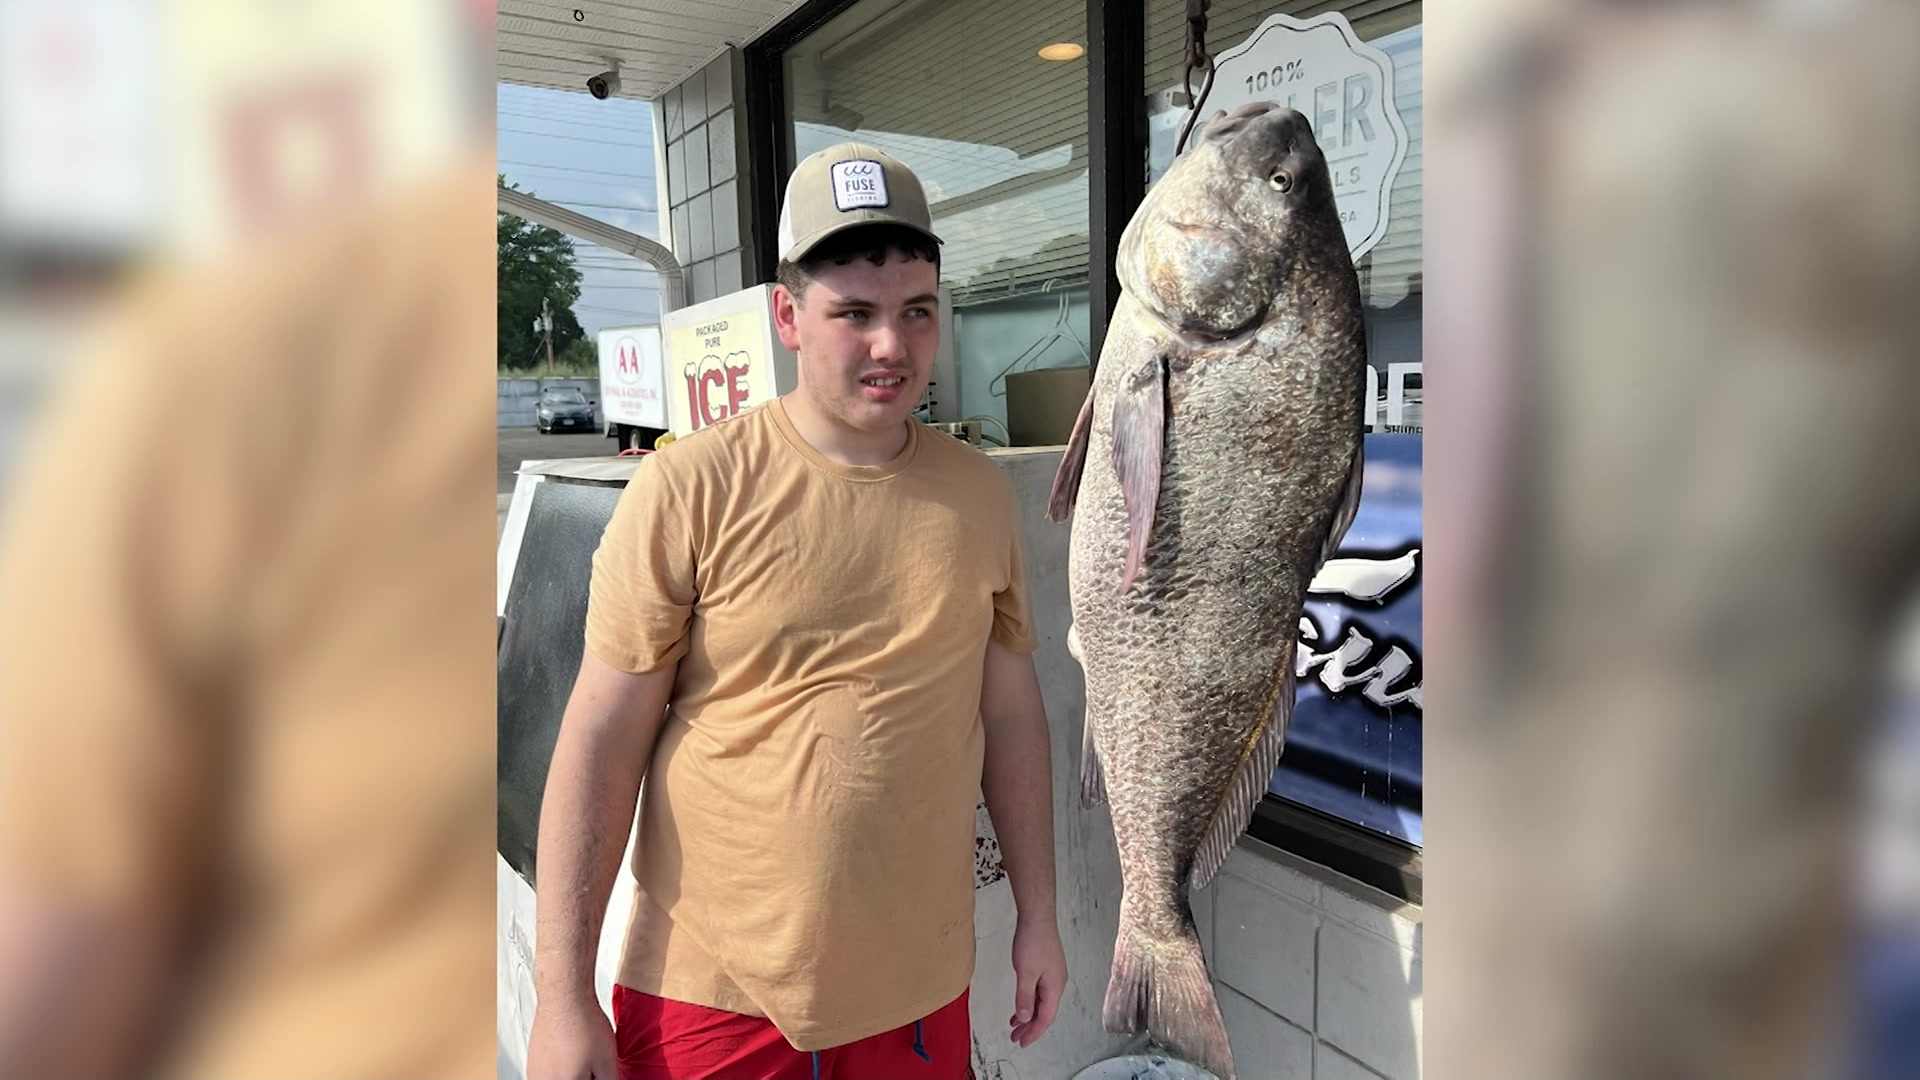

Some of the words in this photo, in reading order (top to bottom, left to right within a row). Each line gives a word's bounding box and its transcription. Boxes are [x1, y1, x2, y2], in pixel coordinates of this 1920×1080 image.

[1246, 59, 1304, 95] 100%
[845, 178, 876, 192] FUSE
[696, 320, 729, 337] PACKAGED
[704, 336, 721, 349] PURE
[684, 350, 752, 431] ICE
